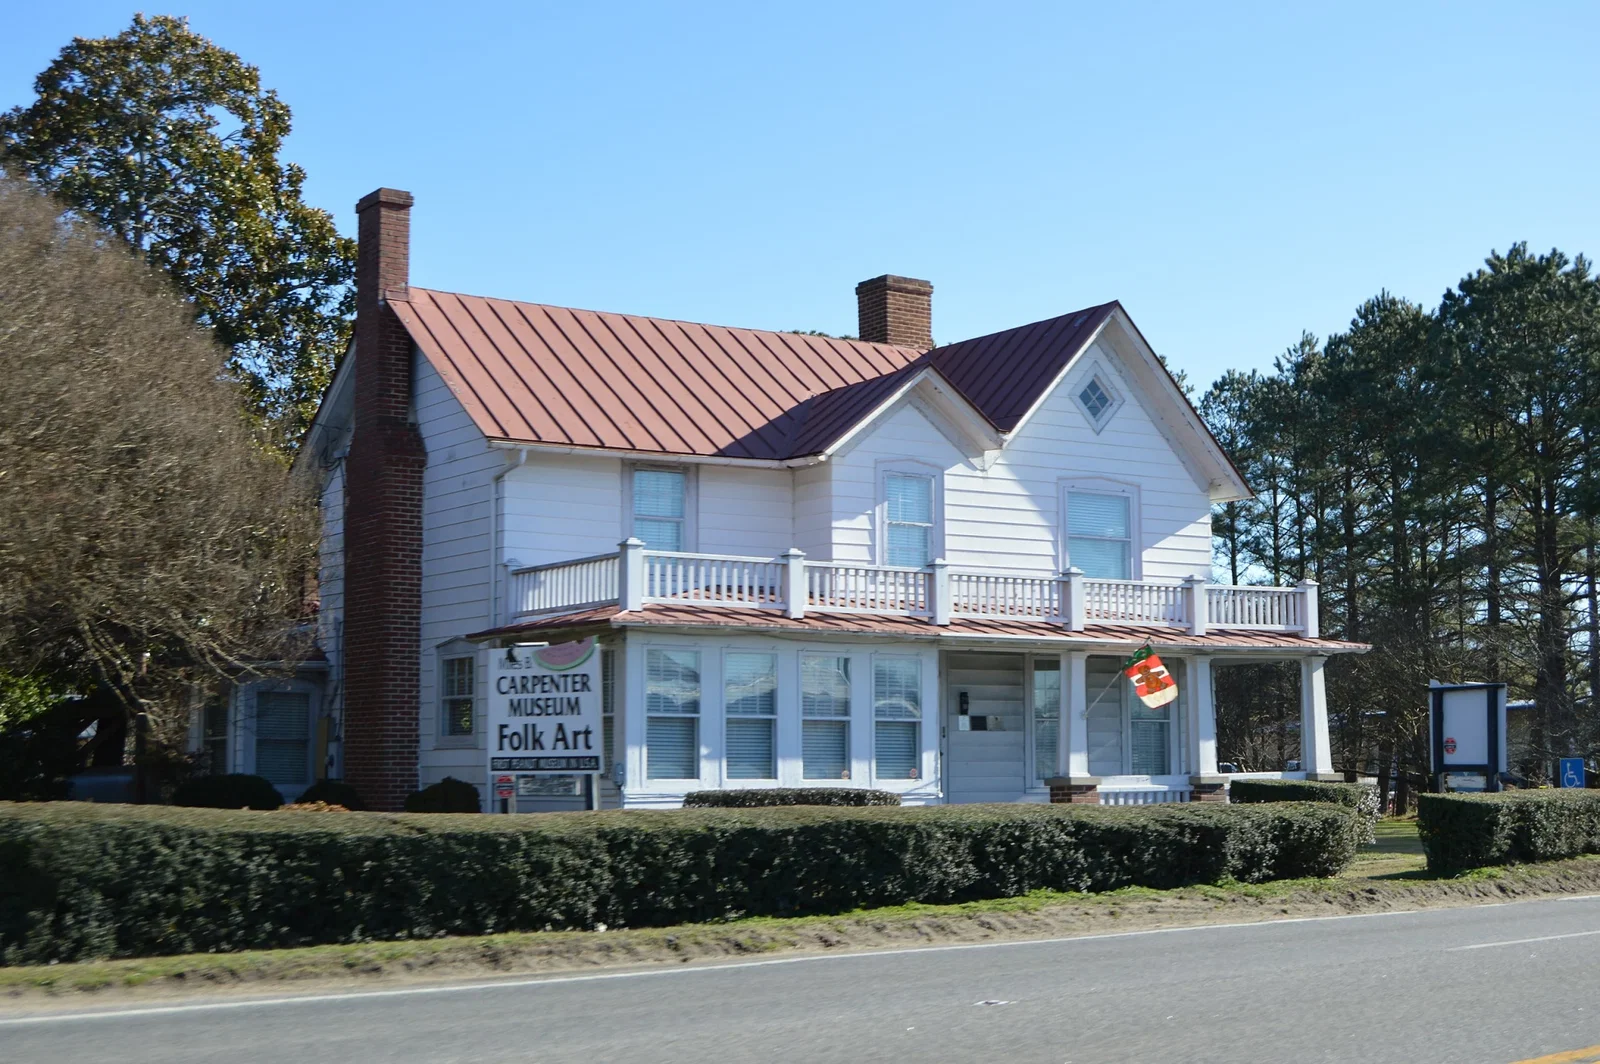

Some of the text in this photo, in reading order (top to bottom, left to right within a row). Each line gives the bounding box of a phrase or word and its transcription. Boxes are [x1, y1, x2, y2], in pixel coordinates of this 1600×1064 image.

[496, 674, 592, 695] CARPENTER
[508, 697, 581, 717] MUSEUM
[498, 722, 593, 752] Folk Art
